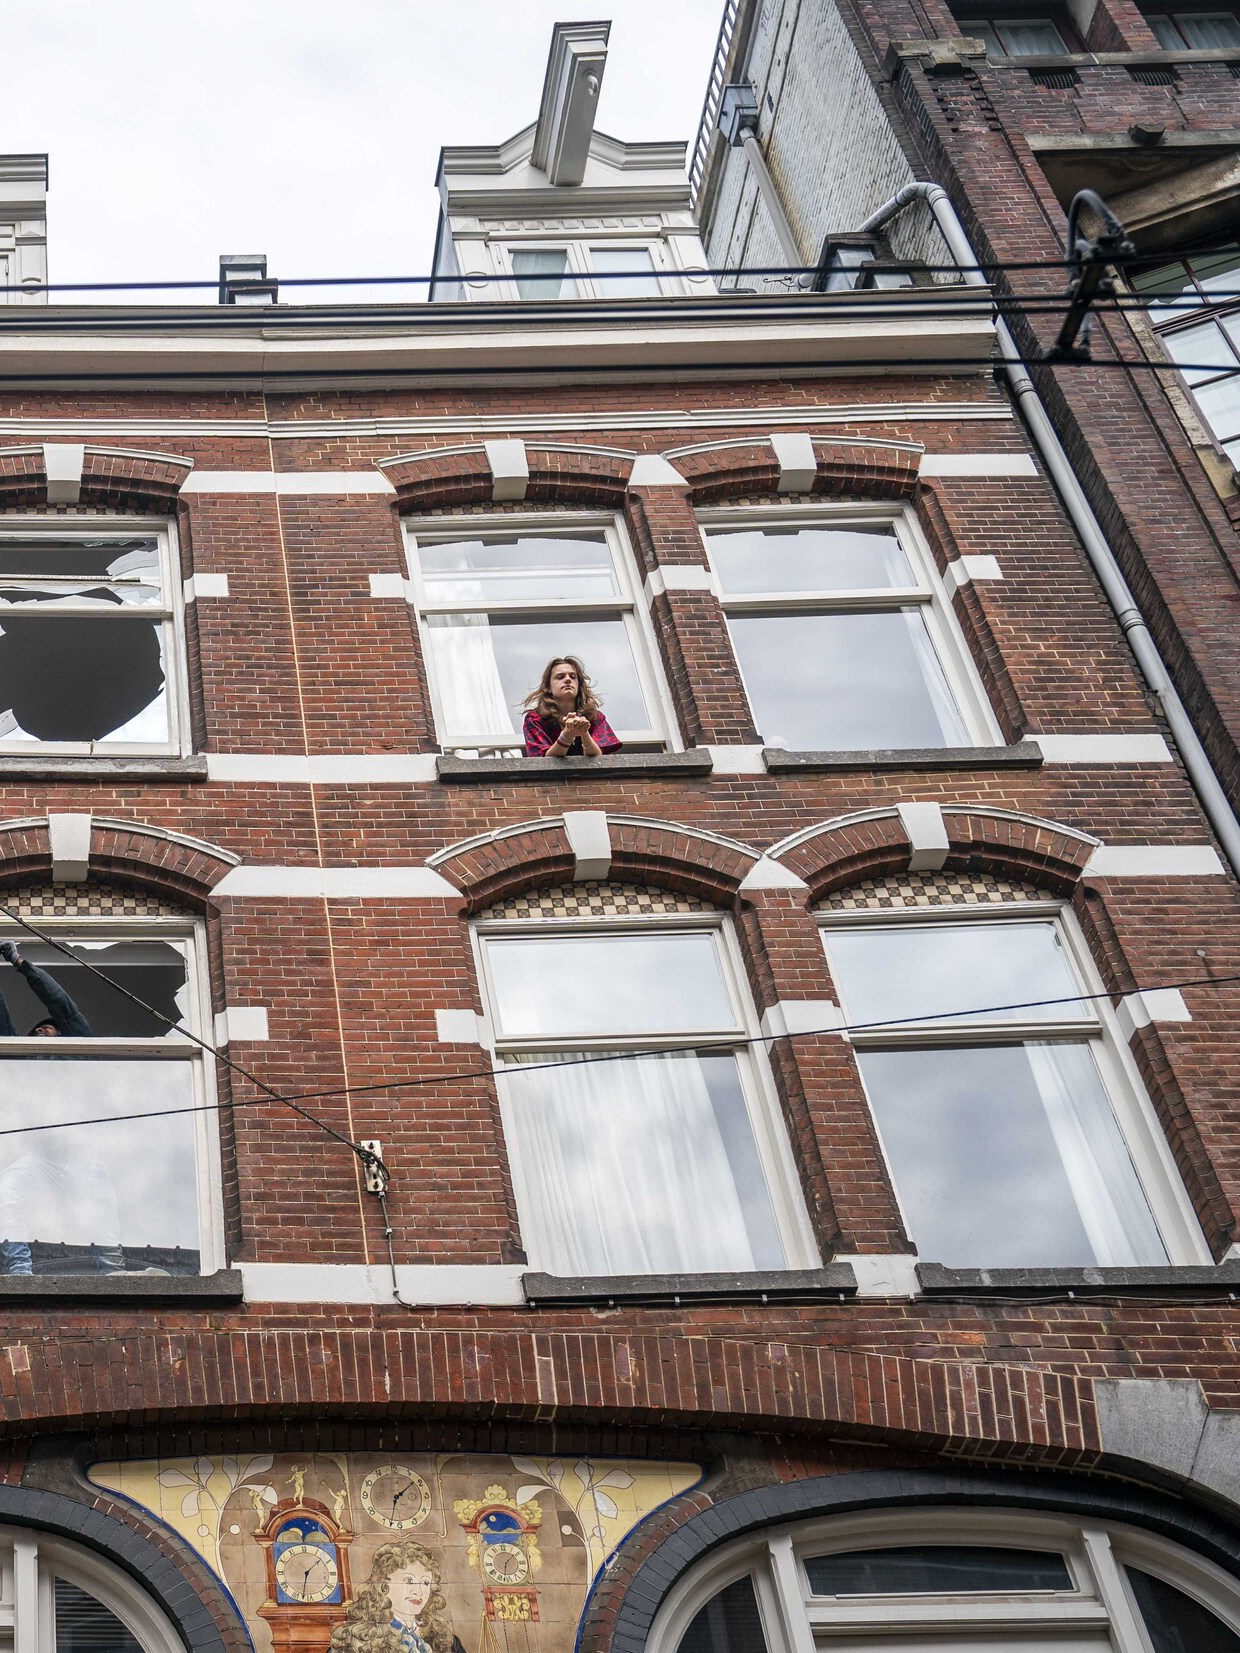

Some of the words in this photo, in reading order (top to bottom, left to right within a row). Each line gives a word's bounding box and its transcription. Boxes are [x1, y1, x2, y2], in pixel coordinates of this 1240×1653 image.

[391, 1464, 398, 1474] 12
[362, 1491, 368, 1499] 9
[368, 1506, 375, 1515] 8
